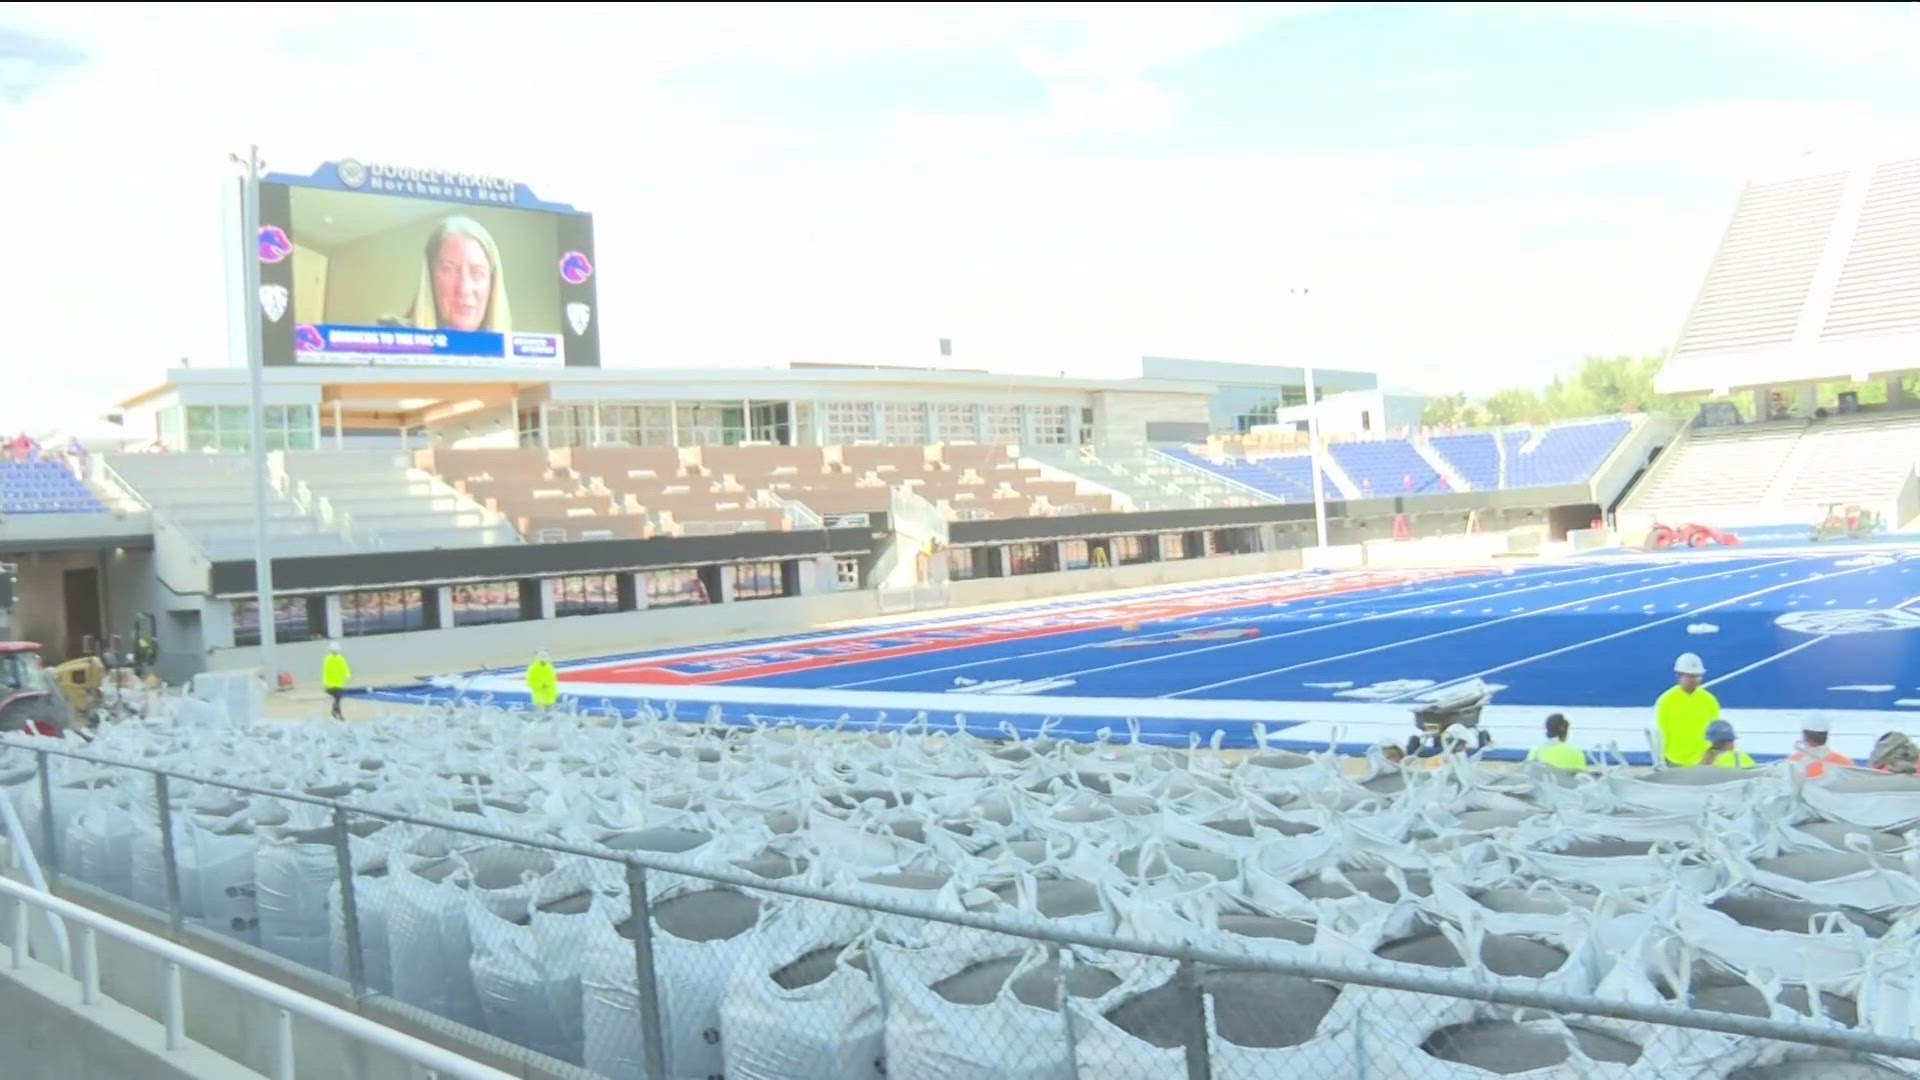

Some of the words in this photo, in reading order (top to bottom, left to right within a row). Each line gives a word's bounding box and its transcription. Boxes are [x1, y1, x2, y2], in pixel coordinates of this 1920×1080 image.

[371, 162, 439, 184] DOUBLE
[458, 171, 514, 192] RANCH
[371, 176, 472, 200] Northwest
[478, 188, 514, 203] Beef
